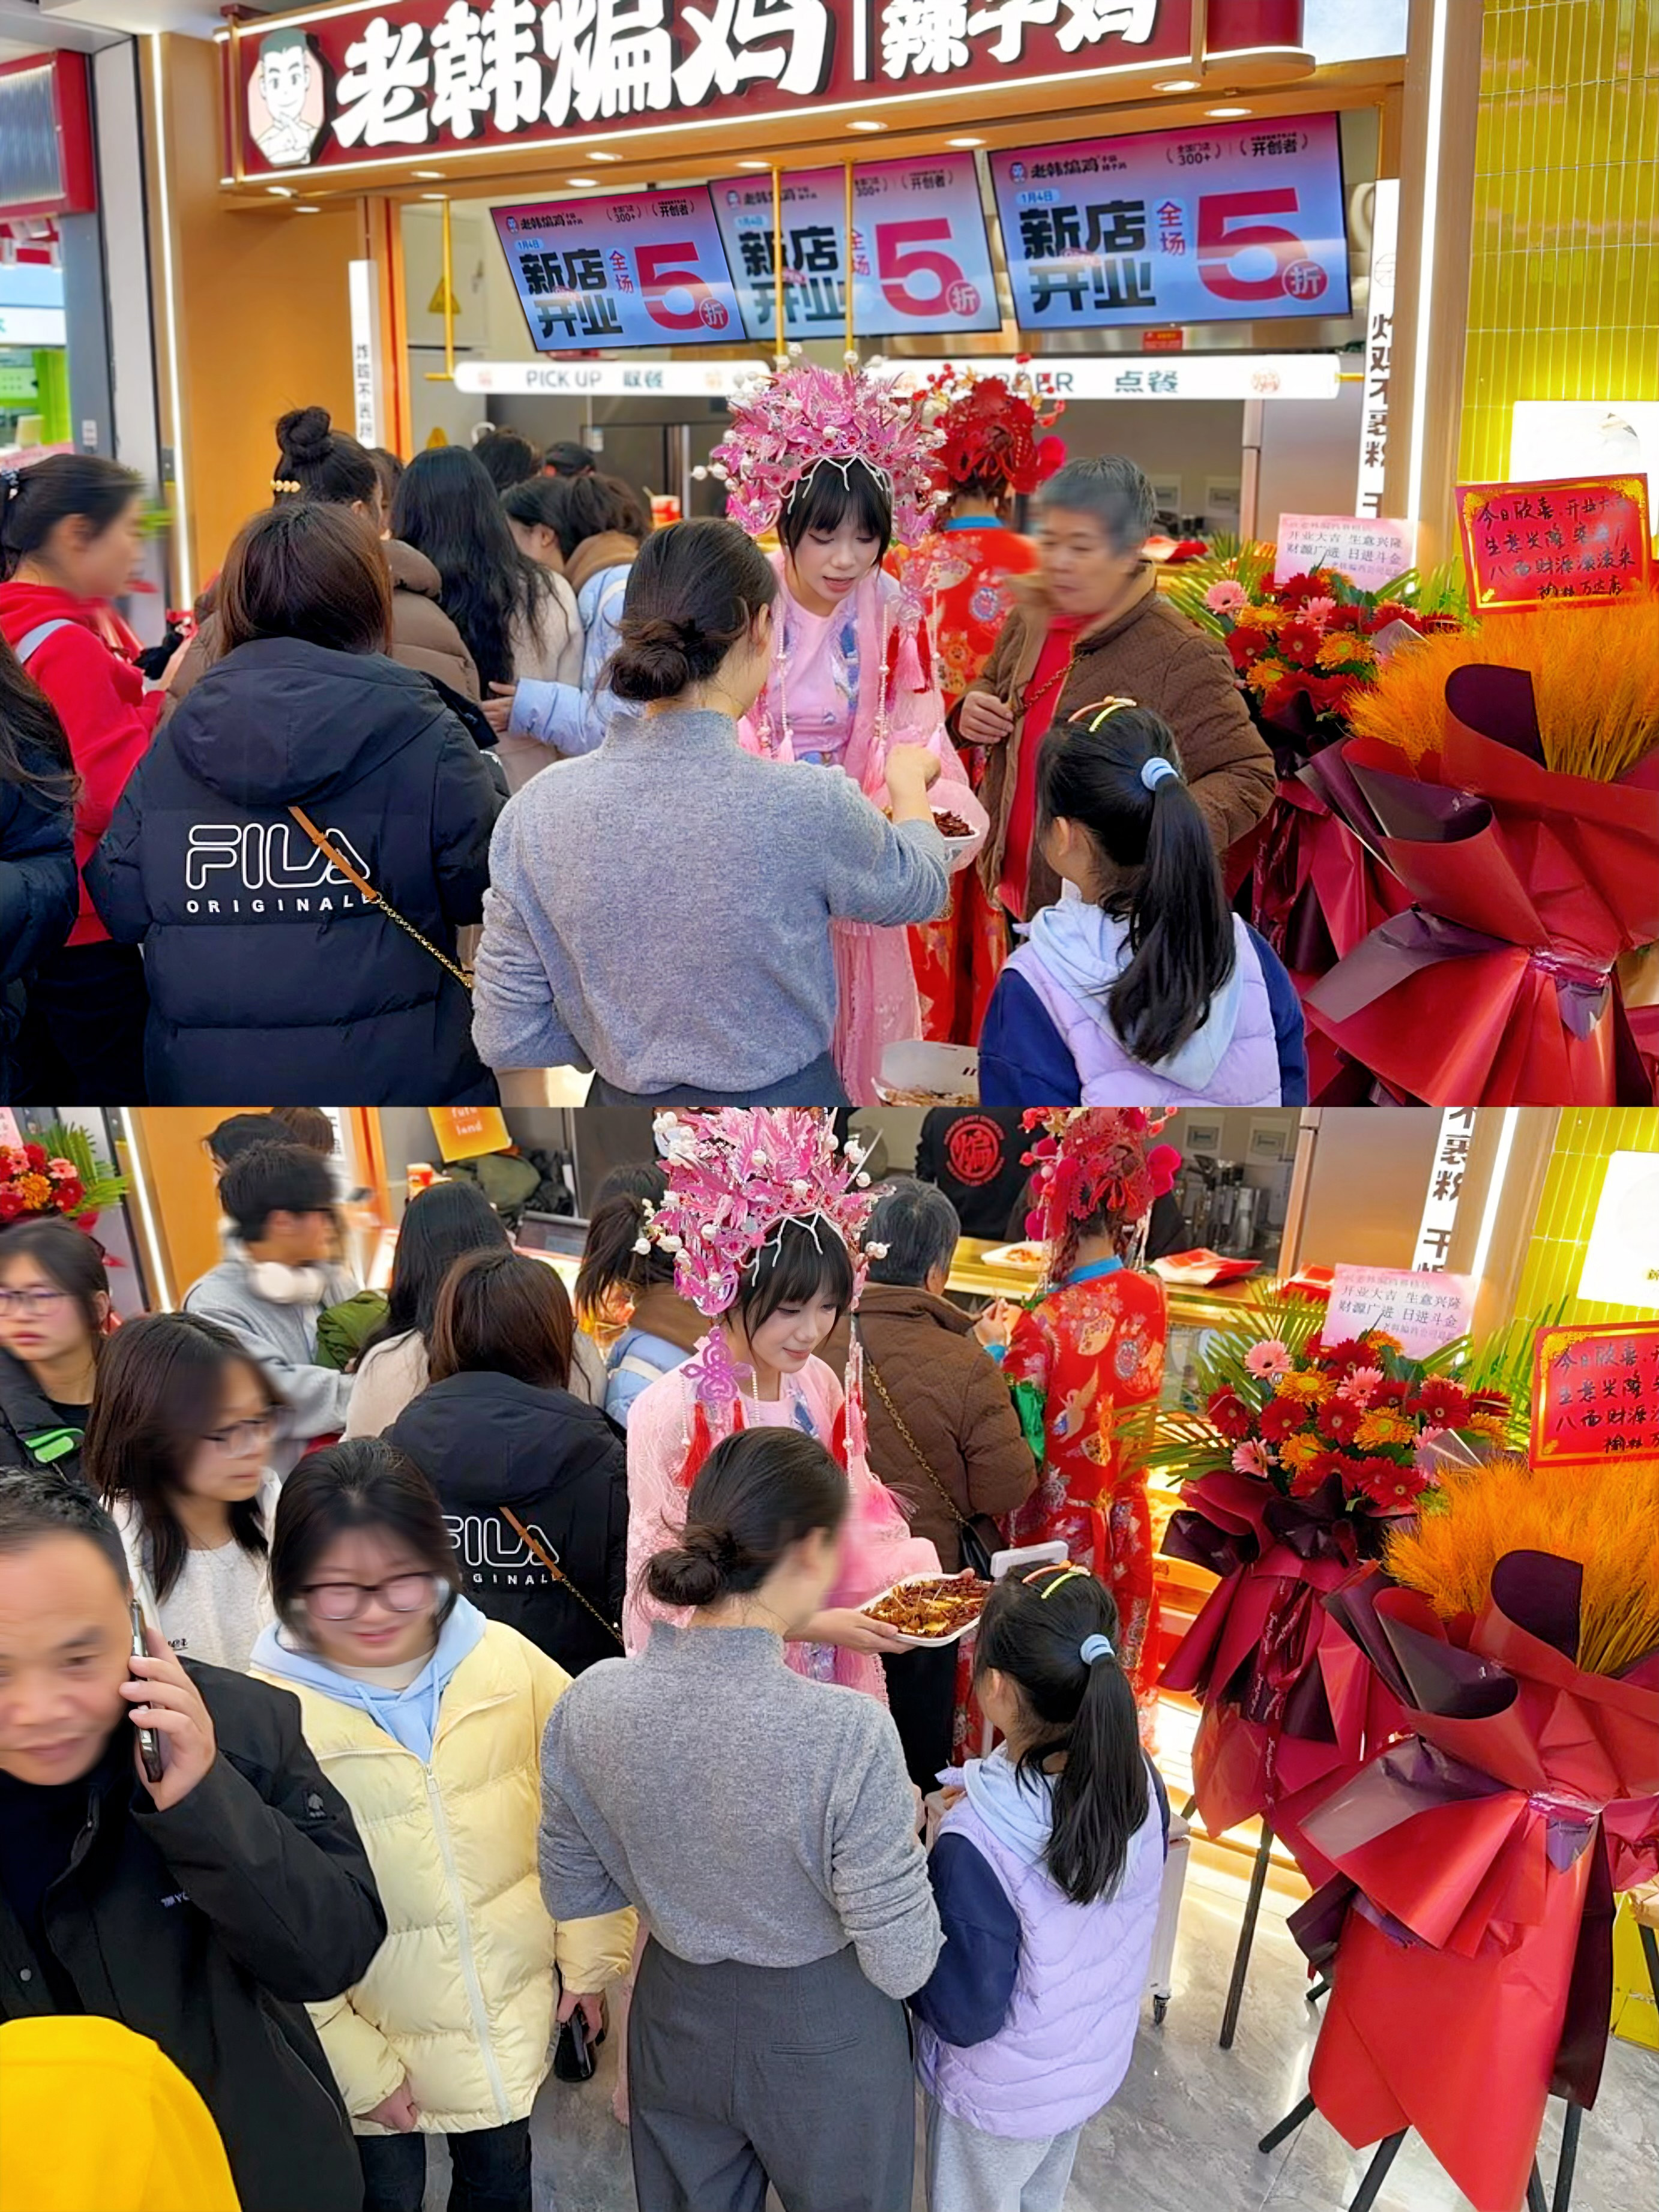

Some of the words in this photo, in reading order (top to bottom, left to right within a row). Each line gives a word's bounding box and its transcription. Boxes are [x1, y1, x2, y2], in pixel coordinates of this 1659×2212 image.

[332, 0, 827, 148] 老韩煸鸡
[1179, 153, 1211, 166] 300+
[1251, 139, 1298, 157] 开创者
[659, 205, 689, 217] 开创者
[1020, 190, 1054, 203] 1月4日
[615, 212, 636, 223] 300+
[1019, 199, 1146, 259] 新店
[1157, 200, 1185, 256] 全场
[739, 225, 839, 276] 新店
[1197, 187, 1309, 301] 5
[519, 248, 607, 295] 新店
[609, 250, 634, 294] 全场
[875, 218, 965, 317] 5
[1289, 266, 1320, 295] 折
[634, 242, 714, 331] 5
[750, 276, 847, 325] 开业
[950, 286, 977, 311] 折
[1029, 259, 1156, 314] 开业
[533, 294, 624, 338] 开业
[702, 302, 726, 326] 折
[526, 370, 570, 388] PICK
[576, 370, 603, 388] UP
[1115, 370, 1179, 394] 点餐
[1288, 530, 1341, 542] 开业大吉
[1349, 534, 1403, 548] 生意兴隆
[1349, 548, 1402, 565] 日进斗金
[186, 823, 370, 890] FILA
[1341, 1285, 1397, 1301] 开业大吉
[1406, 1292, 1462, 1310] 生意兴隆
[1403, 1308, 1458, 1329] 日进斗金
